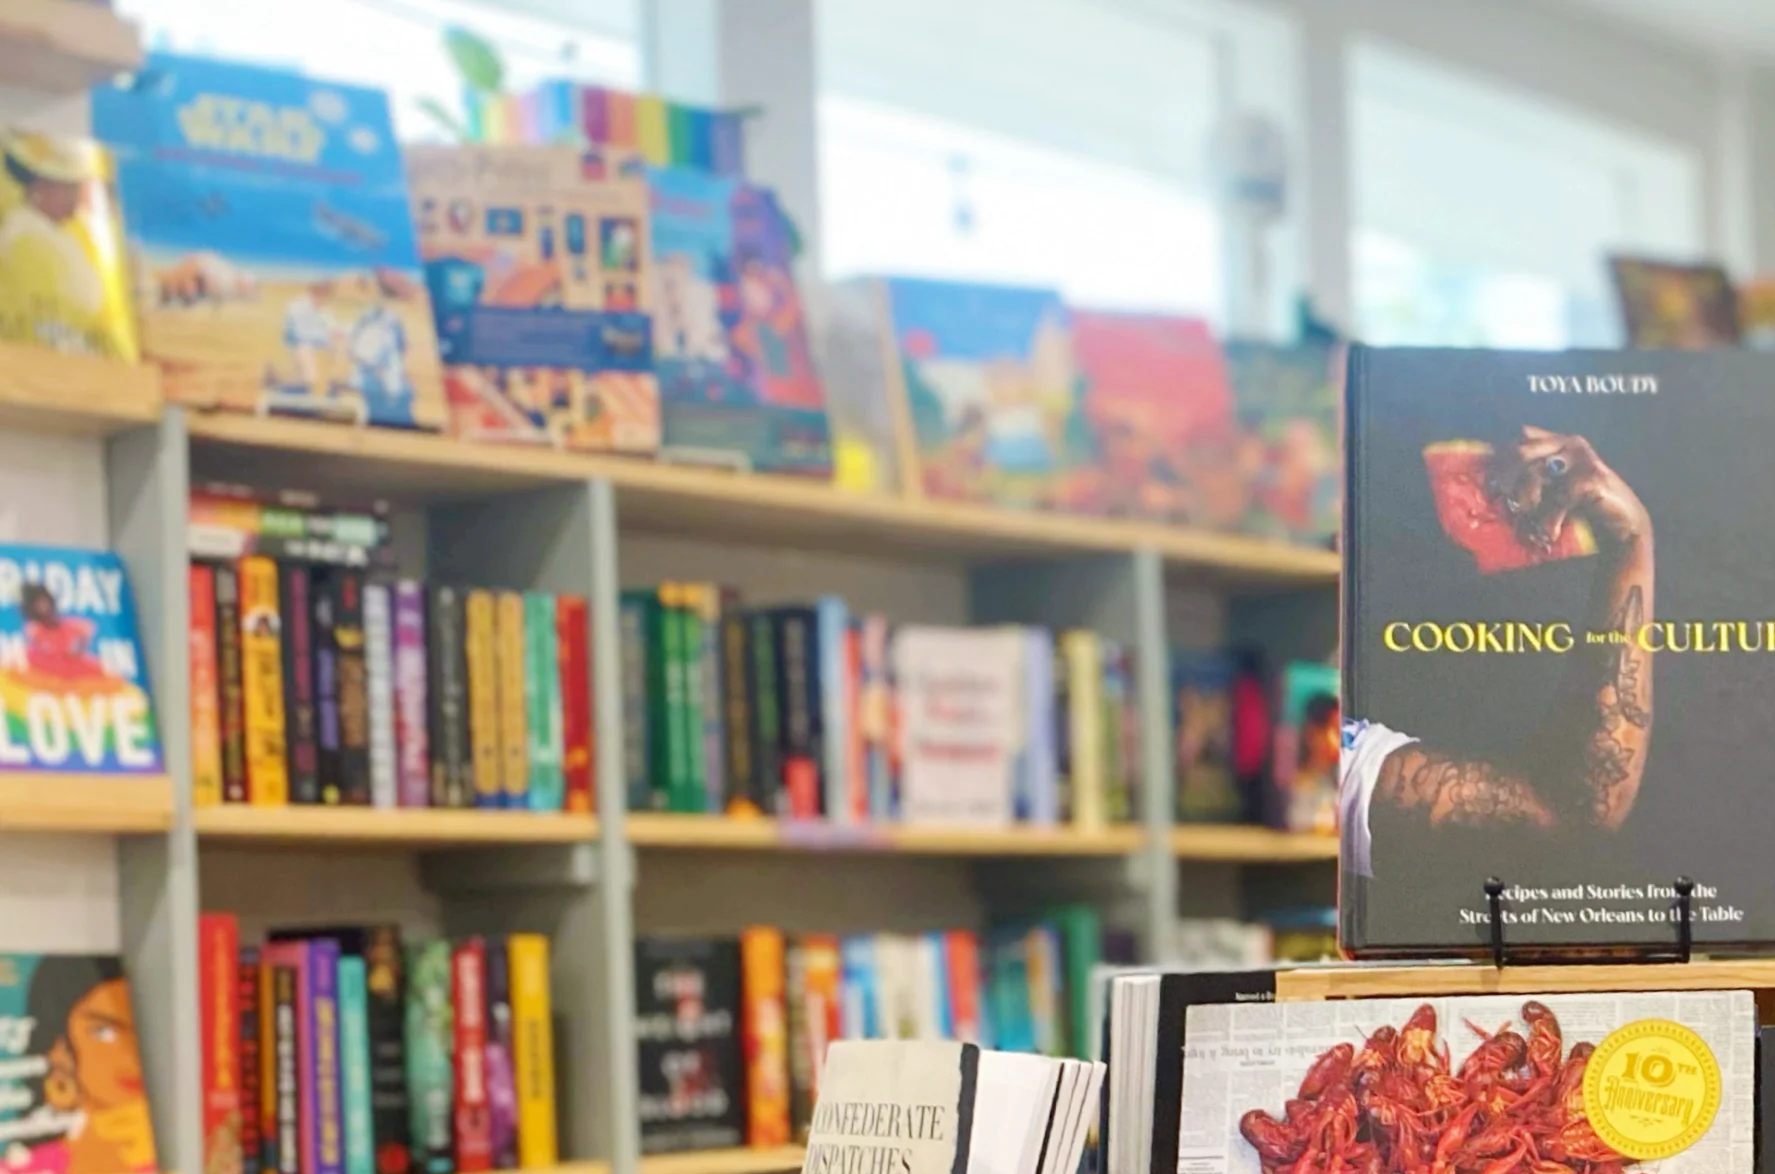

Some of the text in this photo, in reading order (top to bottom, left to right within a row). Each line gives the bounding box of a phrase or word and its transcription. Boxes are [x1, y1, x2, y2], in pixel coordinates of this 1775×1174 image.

[1527, 374, 1659, 394] TOYA BOUDY
[1384, 621, 1575, 653] COOKING
[1586, 630, 1606, 645] for
[1607, 630, 1631, 645] the
[0, 688, 156, 767] LOVE
[1485, 886, 1548, 901] ecipes
[1551, 883, 1584, 900] and
[1586, 883, 1645, 900] Stories
[1459, 908, 1516, 924] Strets
[1520, 907, 1538, 924] of
[1541, 908, 1578, 923] New
[1580, 906, 1645, 923] Orleans
[1648, 907, 1666, 922] to
[1699, 904, 1745, 922] Table
[1604, 1075, 1695, 1127] Anniversary
[813, 1100, 946, 1142] CONFEDERATE
